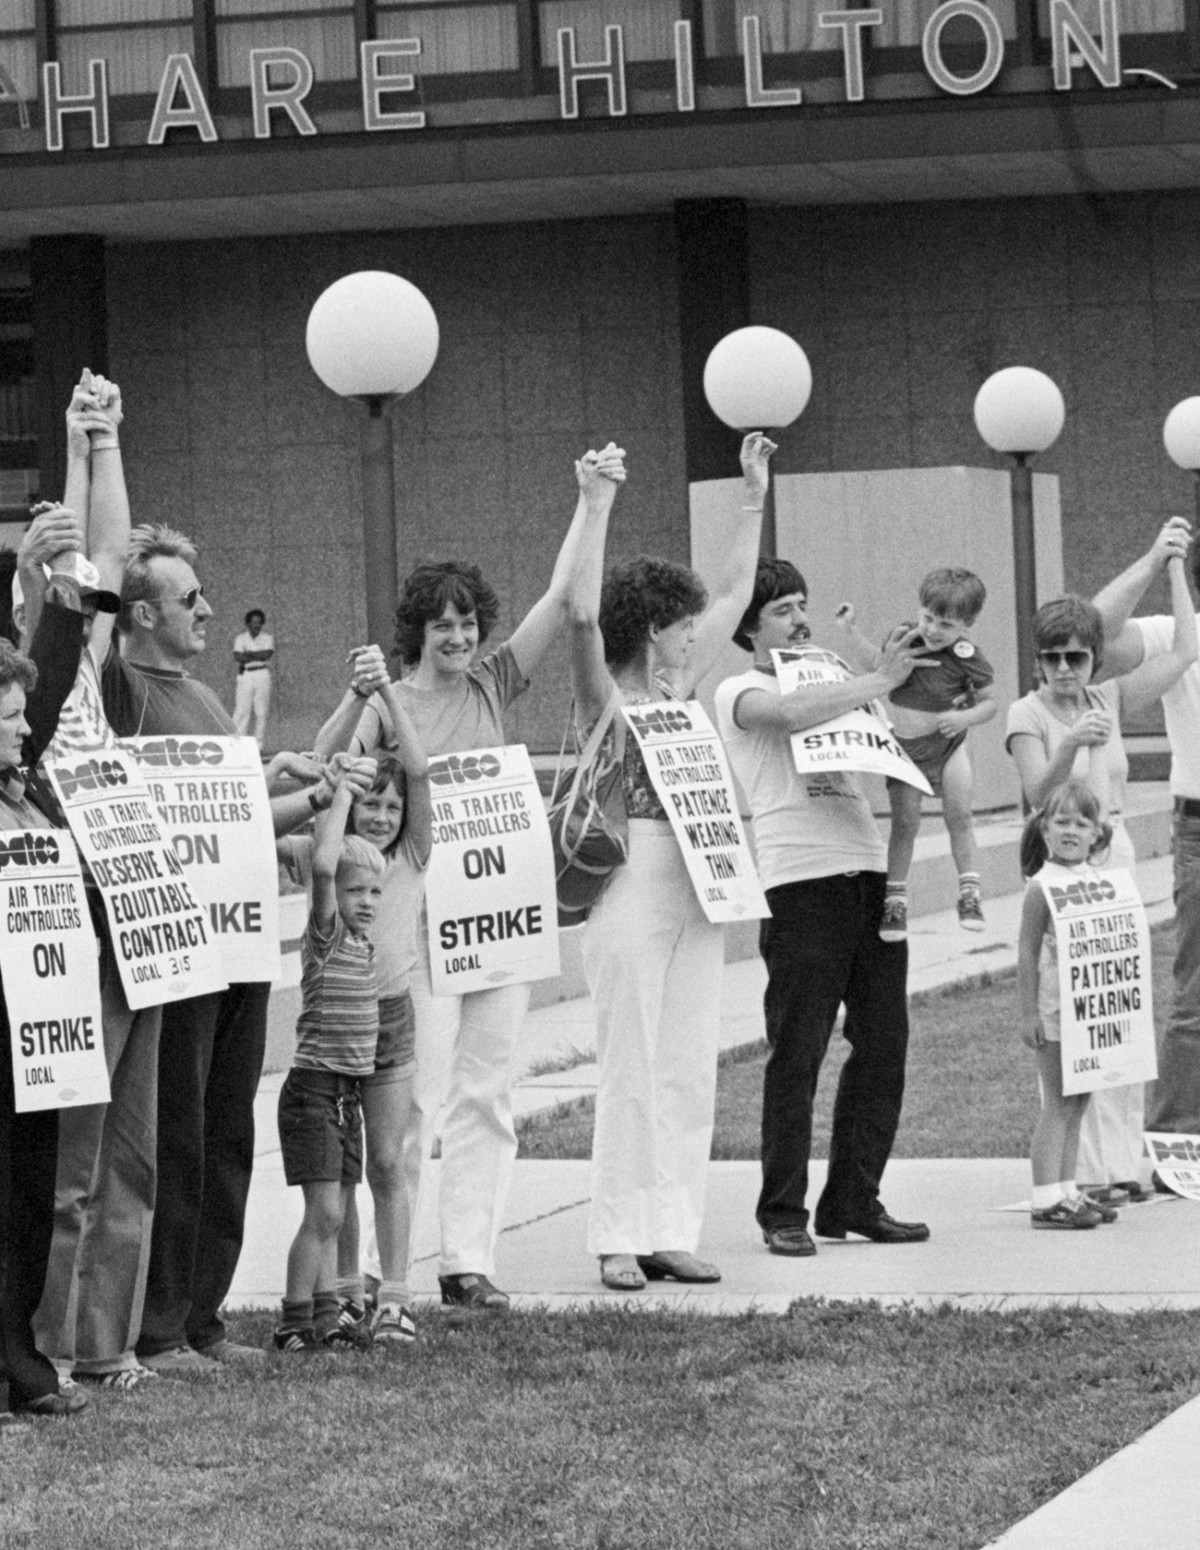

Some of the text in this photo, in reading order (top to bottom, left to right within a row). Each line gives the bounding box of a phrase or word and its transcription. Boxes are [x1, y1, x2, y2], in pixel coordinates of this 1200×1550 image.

[556, 0, 1121, 120] HILTON
[798, 669, 824, 682] AIR
[656, 744, 716, 767] AIR TRAFFIC
[810, 751, 850, 762] LOCAL
[428, 754, 501, 786] atco
[147, 783, 166, 802] IR
[174, 781, 248, 802] TRAFFIC
[460, 791, 526, 818] TRAFFIC
[670, 788, 731, 818] PATIENCE
[83, 801, 153, 829] AIR TRAFFIC
[157, 803, 254, 824] NTROLLERS'
[684, 821, 740, 849] WEARING
[171, 834, 220, 866] ON
[462, 845, 506, 880] ON
[91, 850, 164, 888] DESERVE
[8, 883, 77, 908] AIR TRAFFIC
[110, 882, 198, 924] EQUITABLE
[704, 887, 727, 902] LOCAL
[204, 901, 262, 934] IKE
[439, 905, 542, 950] STRIKE
[1069, 913, 1136, 939] AIR TRAFFIC
[119, 916, 208, 961] CONTRACT
[33, 942, 67, 978] ON
[131, 963, 162, 984] LOCAL
[445, 954, 481, 974] LOCAL
[1070, 955, 1140, 991] PATIENCE
[1073, 987, 1141, 1022] WEARING
[19, 1016, 95, 1057] STRIKE
[25, 1066, 55, 1086] LOCAL
[1074, 1057, 1100, 1074] LOCAL
